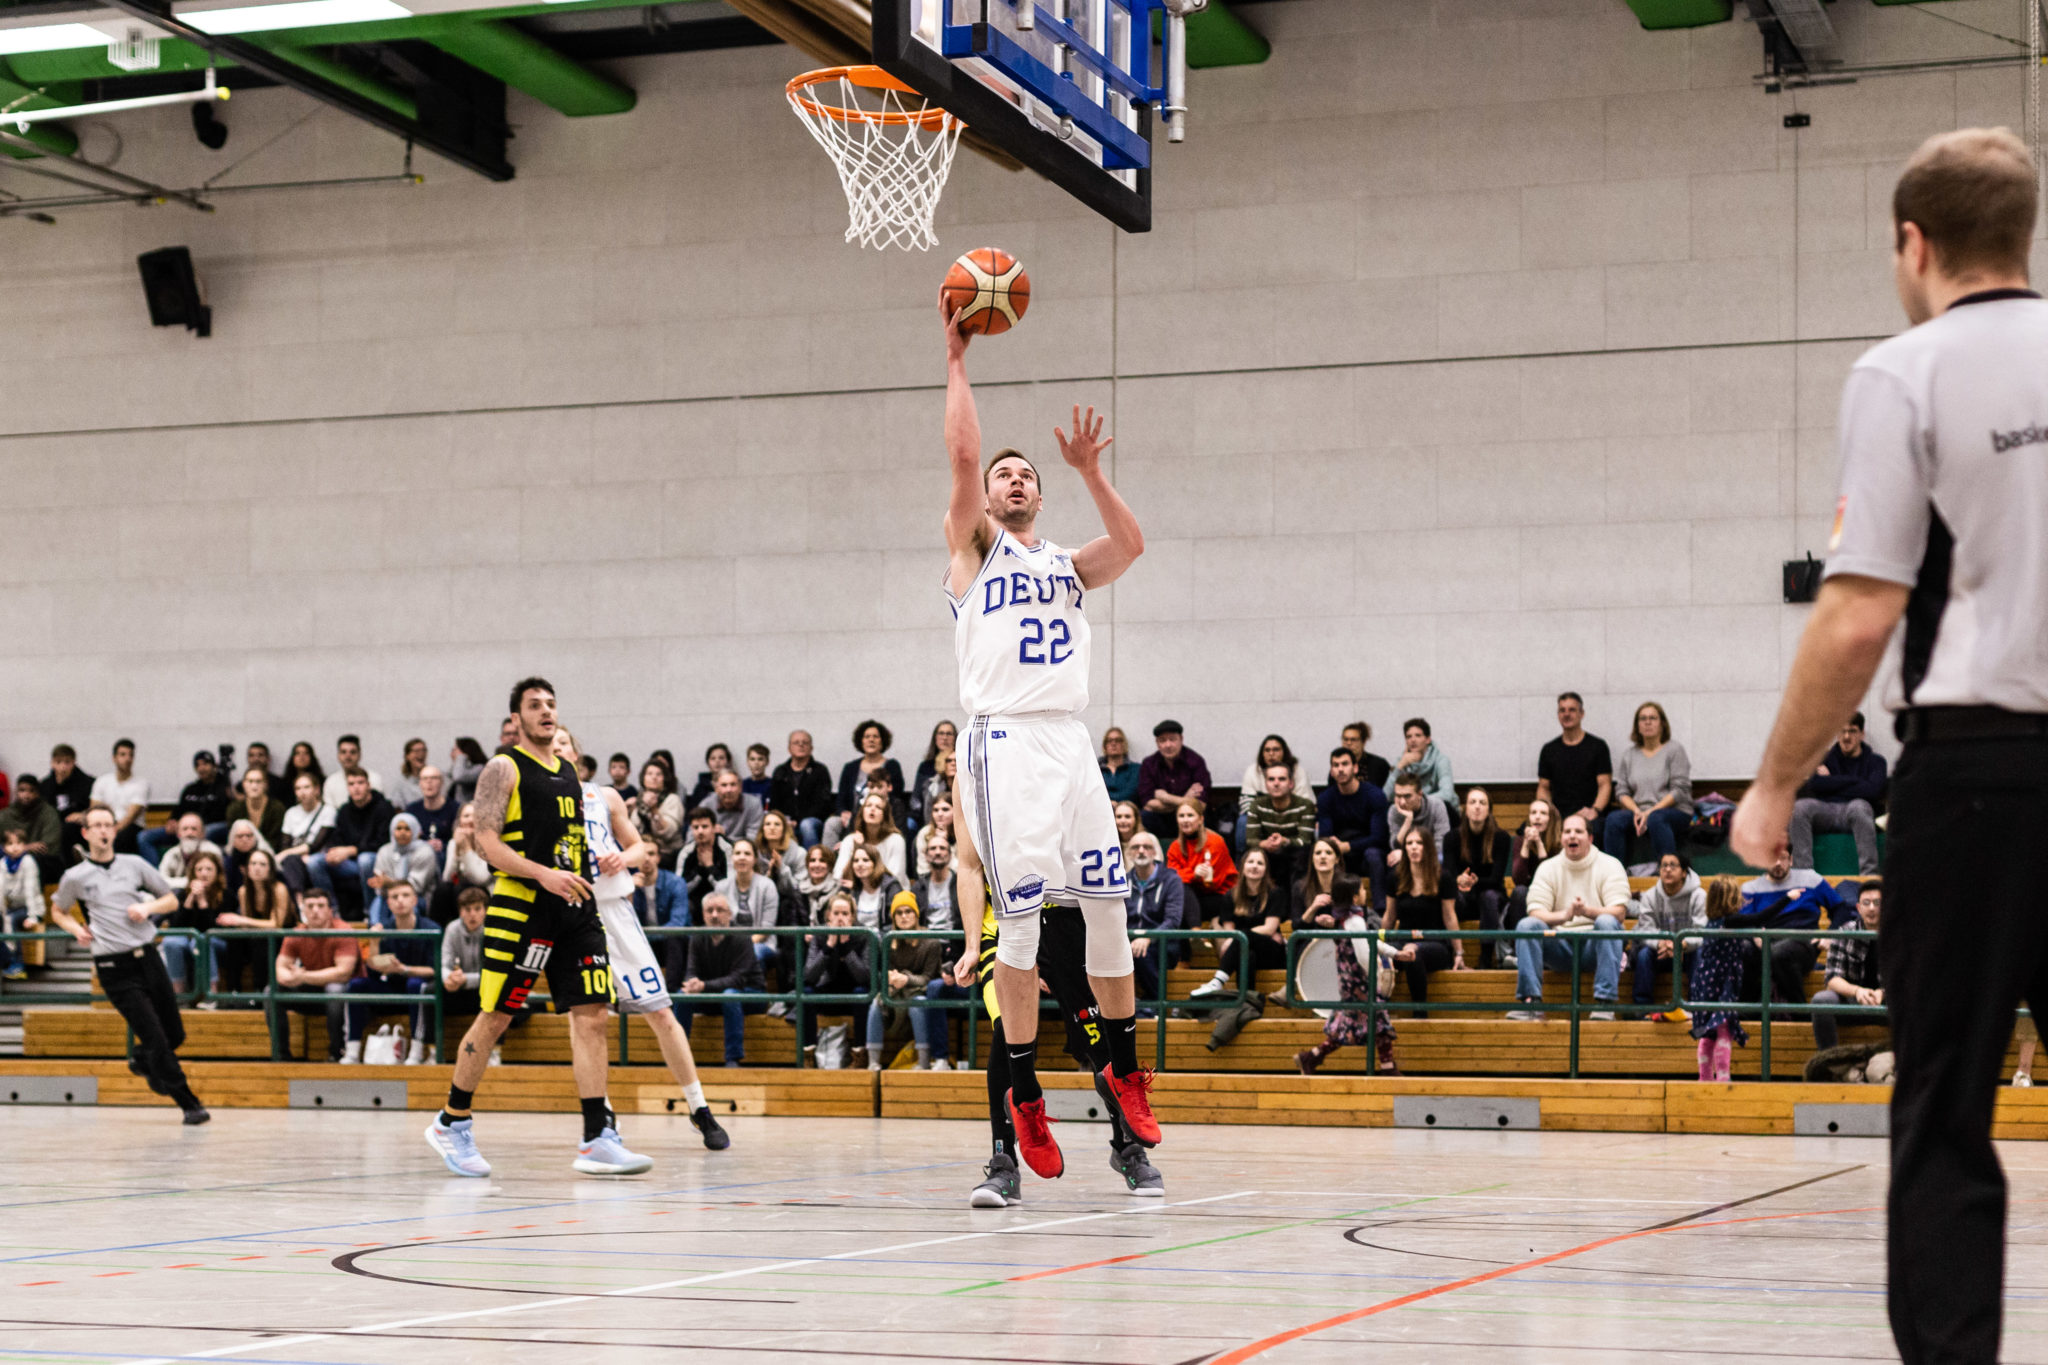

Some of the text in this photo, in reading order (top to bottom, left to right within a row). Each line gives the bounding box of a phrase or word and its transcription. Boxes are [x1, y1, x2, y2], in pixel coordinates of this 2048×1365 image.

[1019, 617, 1074, 665] 22
[556, 796, 576, 818] 10
[1081, 846, 1126, 886] 22
[581, 969, 607, 995] 10
[622, 966, 661, 1000] 19
[1083, 1022, 1101, 1045] 5
